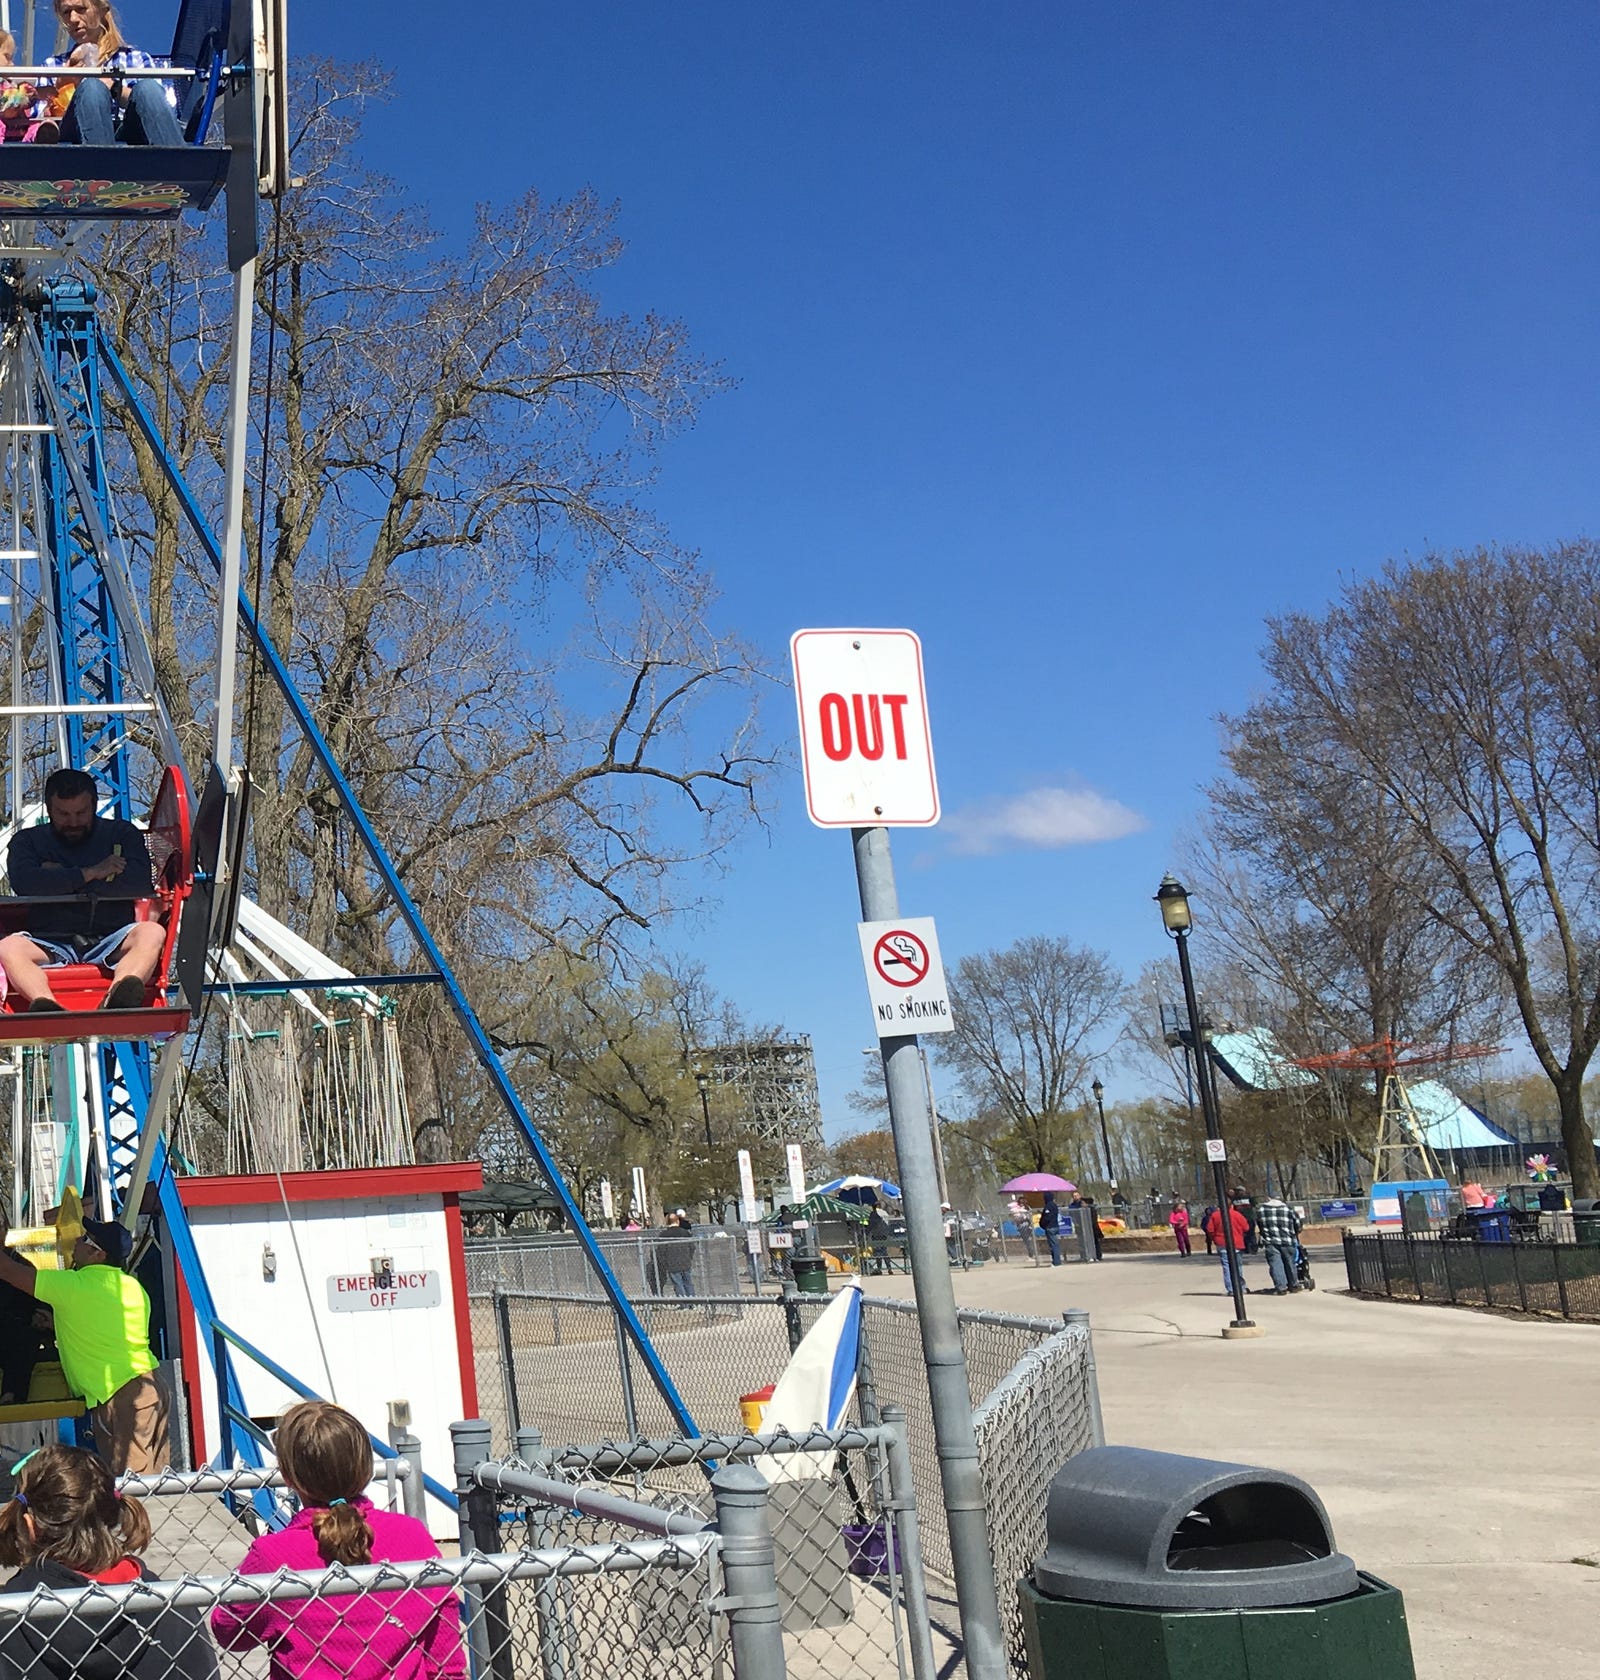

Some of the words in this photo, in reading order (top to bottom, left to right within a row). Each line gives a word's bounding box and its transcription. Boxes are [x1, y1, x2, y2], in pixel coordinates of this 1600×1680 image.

[819, 693, 908, 761] OUT
[878, 1004, 893, 1020] NO
[899, 1000, 946, 1019] SMOKING
[776, 1236, 786, 1245] IN
[337, 1273, 427, 1292] EMERGENCY
[370, 1292, 398, 1307] OFF
